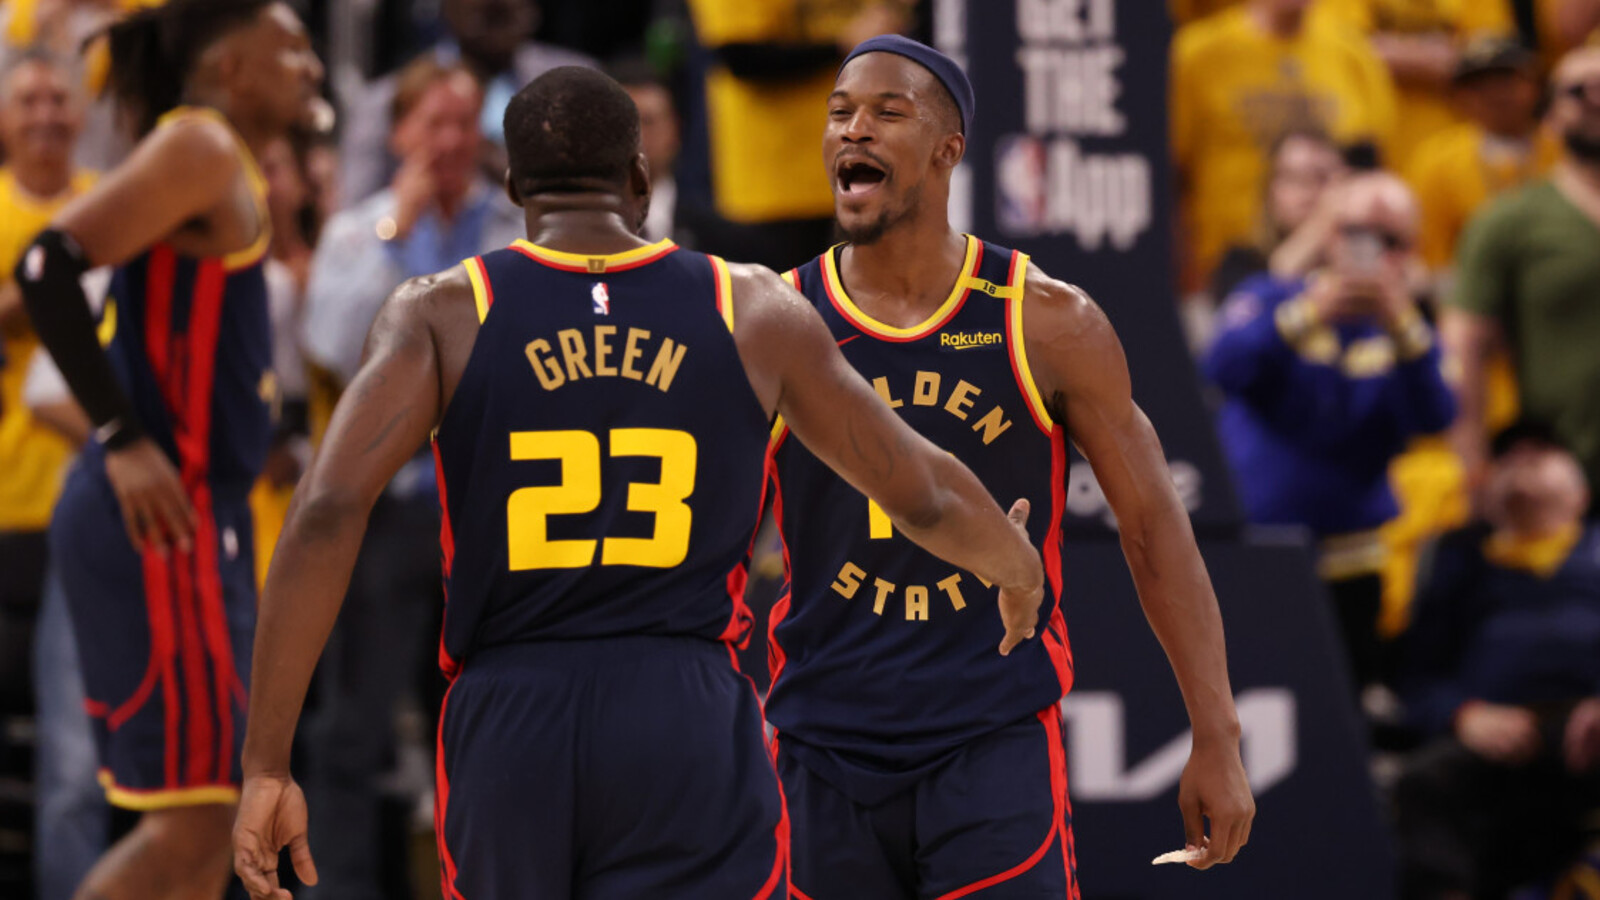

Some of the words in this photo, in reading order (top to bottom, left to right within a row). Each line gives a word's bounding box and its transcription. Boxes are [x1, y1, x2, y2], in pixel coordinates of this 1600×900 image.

[1016, 49, 1125, 136] THE
[1045, 139, 1151, 249] App
[982, 281, 997, 295] 16
[525, 325, 687, 392] GREEN
[940, 331, 1002, 349] Rakuten
[873, 370, 1012, 445] LDEN
[507, 428, 697, 571] 23
[831, 561, 993, 621] STAT
